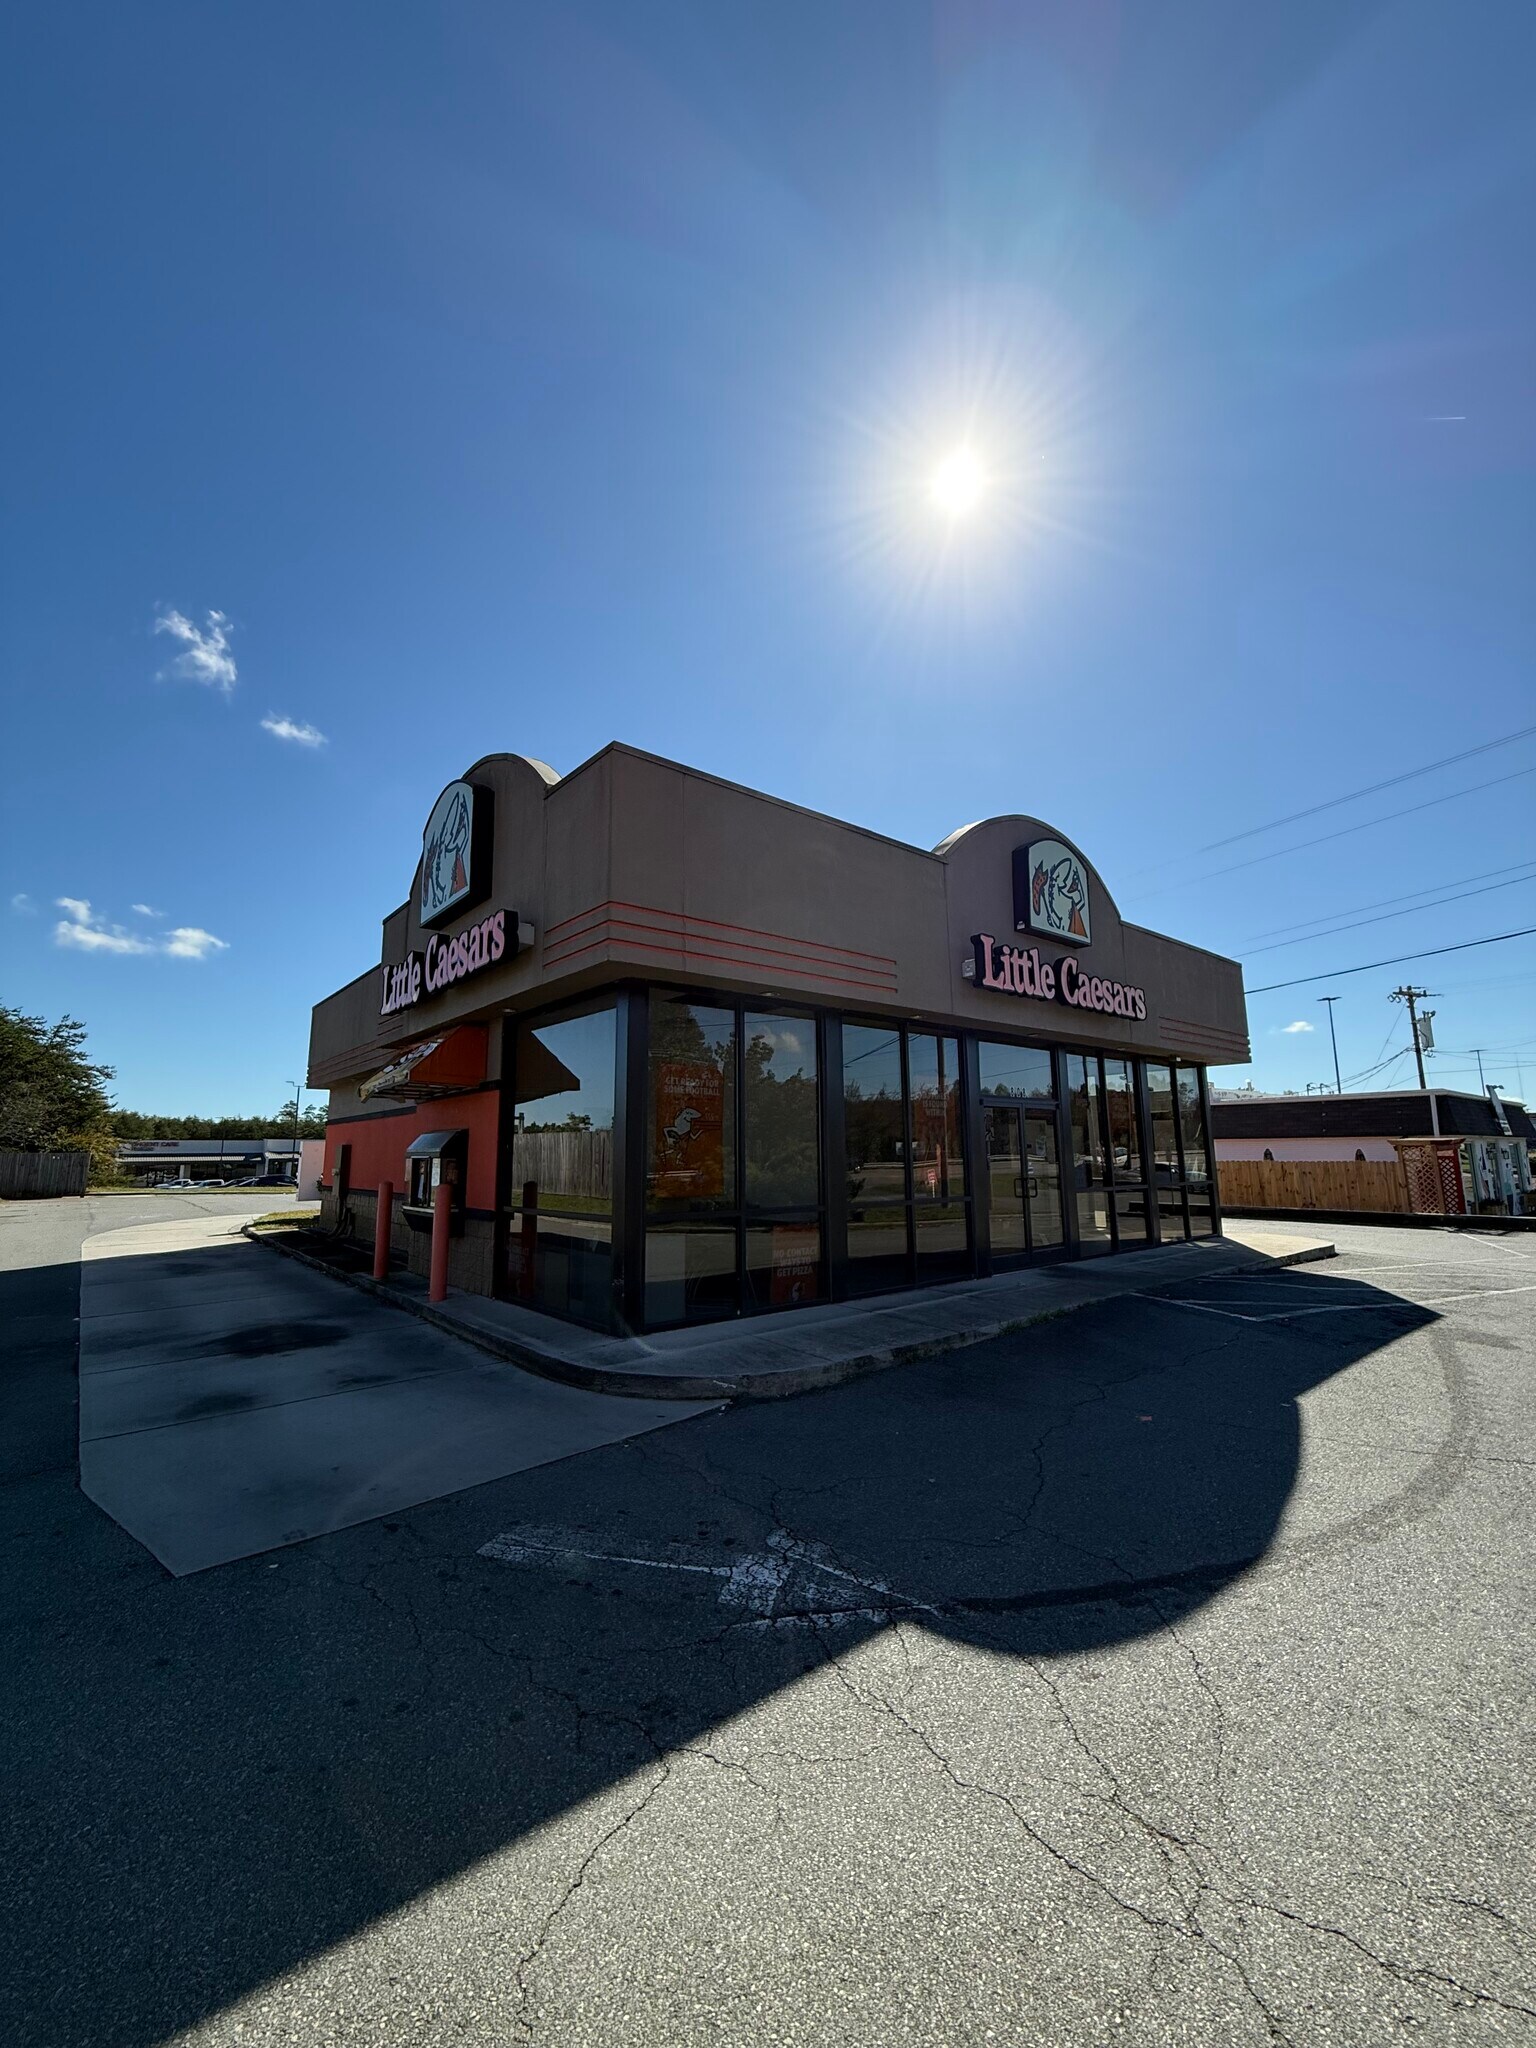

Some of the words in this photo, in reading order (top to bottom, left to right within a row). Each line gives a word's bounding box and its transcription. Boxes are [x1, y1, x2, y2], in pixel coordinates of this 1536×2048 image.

[380, 950, 421, 1015] Little
[425, 909, 505, 993] Caesars
[977, 933, 1055, 999] Little
[1059, 956, 1147, 1020] Caesars
[685, 1086, 720, 1096] FOOTBALL
[773, 1249, 785, 1258] NO
[786, 1246, 818, 1257] CONTACT
[777, 1267, 792, 1277] GET
[792, 1265, 813, 1276] PIZZA
